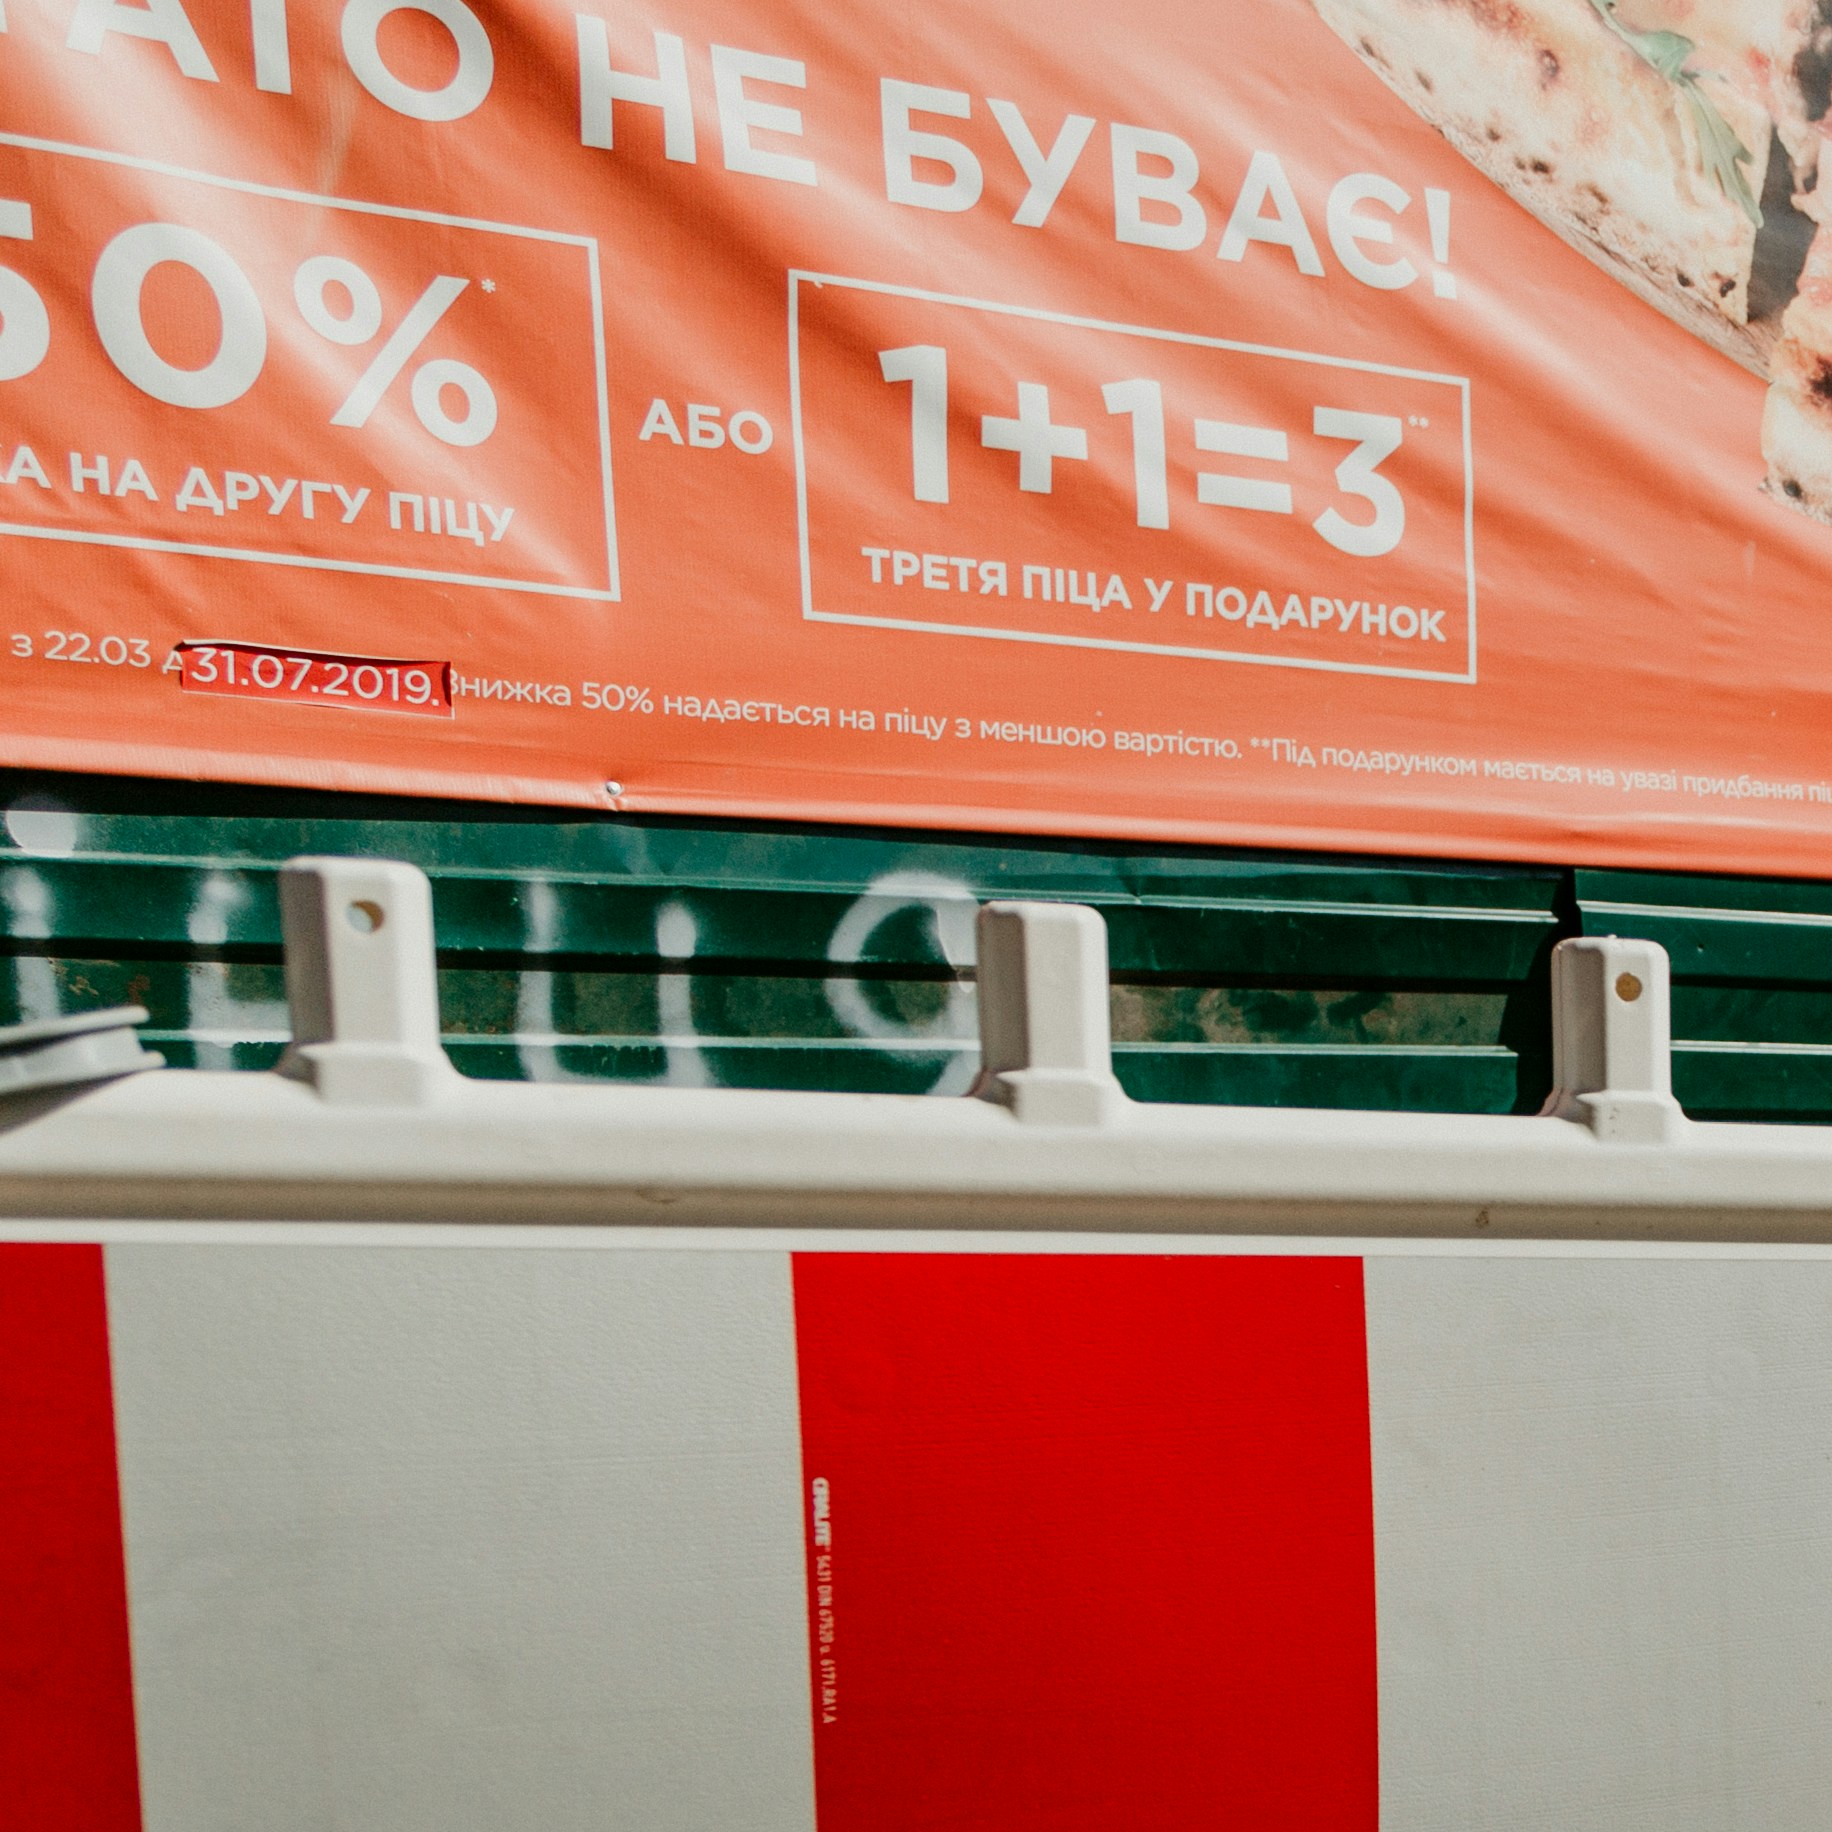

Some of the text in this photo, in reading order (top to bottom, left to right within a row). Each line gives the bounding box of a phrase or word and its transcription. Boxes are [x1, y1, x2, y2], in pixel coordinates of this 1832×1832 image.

[576, 14, 818, 187] НЕ
[880, 78, 1458, 300] БУВАЄ!
[639, 398, 774, 454] АБО
[69, 451, 159, 501] НА
[175, 467, 371, 523] ДРУГУ
[389, 492, 515, 546] ПІЦУ
[861, 547, 1447, 643] ТРЕТЯ ПІЦА У ПОДАРУНОК
[11, 633, 33, 657] з
[44, 630, 151, 667] 22.03
[191, 646, 439, 707] 31.07.2019.
[582, 682, 654, 713] 50%
[663, 695, 830, 727] надається
[839, 709, 875, 730] на
[885, 708, 947, 740] піцу
[955, 718, 971, 738] з
[980, 720, 1106, 748] меншою
[1114, 730, 1242, 758] вартістю.
[1322, 747, 1477, 777] подарунком
[1484, 760, 1581, 784] мається
[1588, 769, 1615, 787] на
[1621, 769, 1677, 793] увазі
[1683, 773, 1803, 801] придбання
